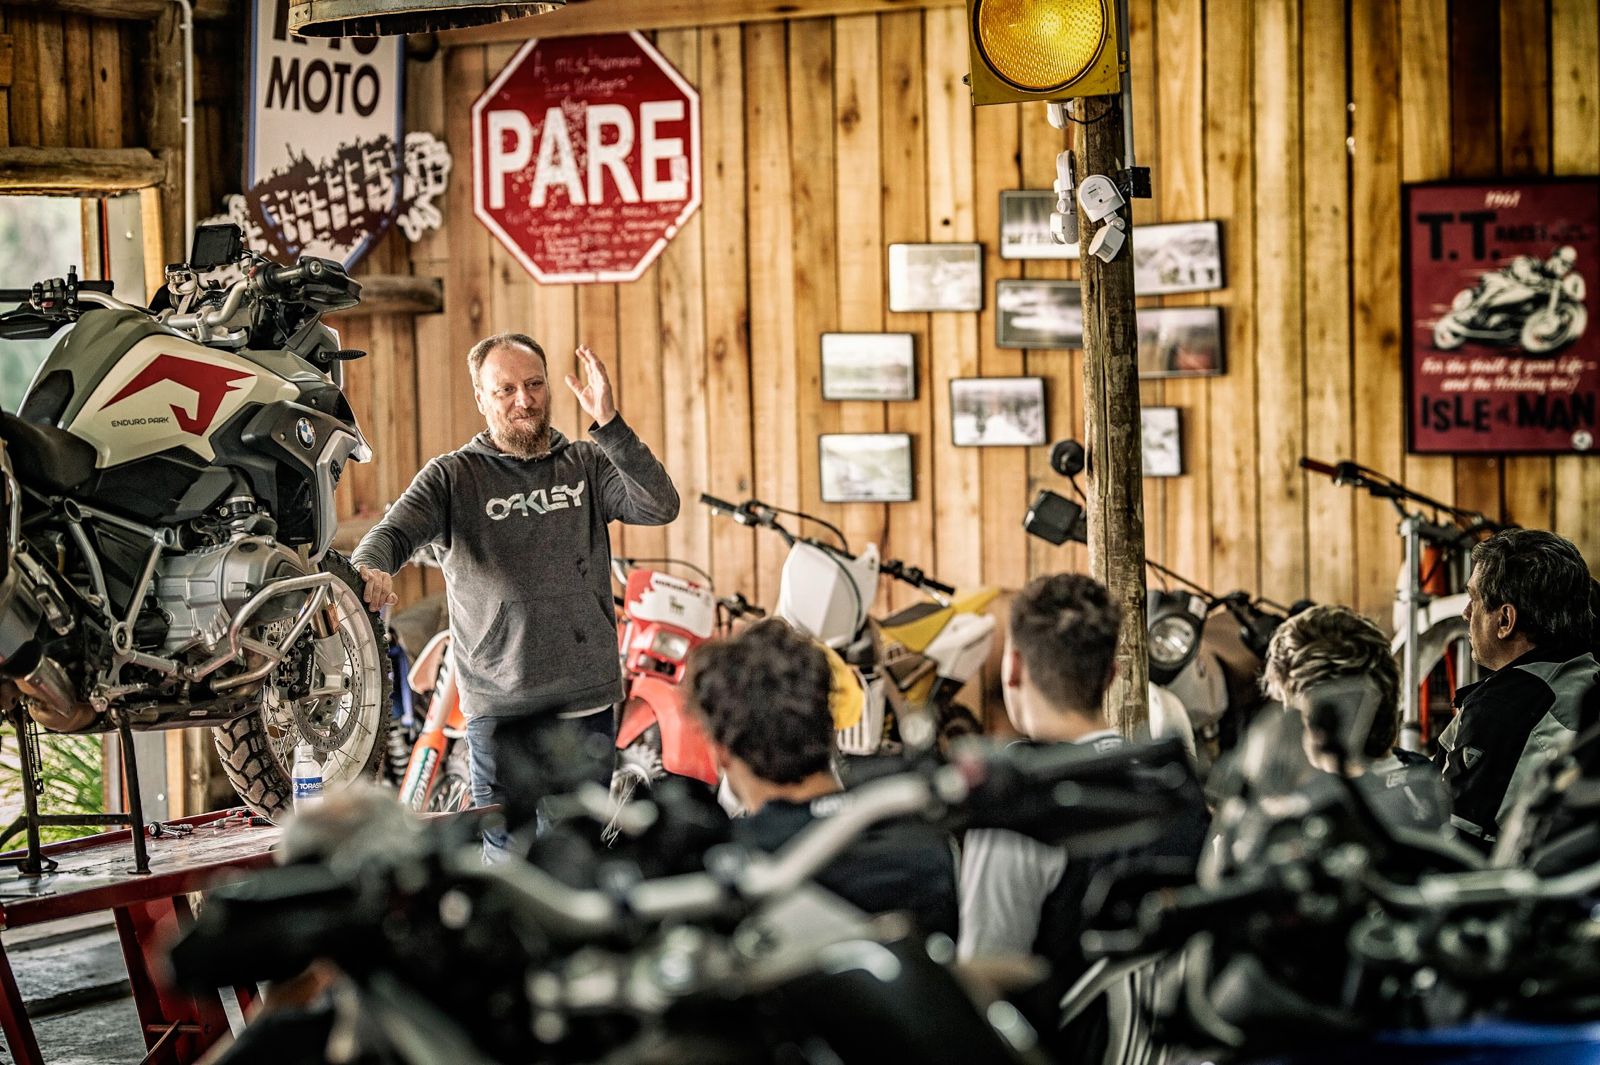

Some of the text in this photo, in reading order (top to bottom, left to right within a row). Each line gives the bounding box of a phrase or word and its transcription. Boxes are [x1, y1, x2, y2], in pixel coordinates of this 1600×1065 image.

[265, 56, 381, 117] MOTO
[488, 100, 688, 209] PARE
[111, 416, 170, 428] ENDURO PARK
[1421, 394, 1491, 432] ISLE
[1517, 392, 1596, 432] MAN
[485, 480, 585, 520] OAKLEY
